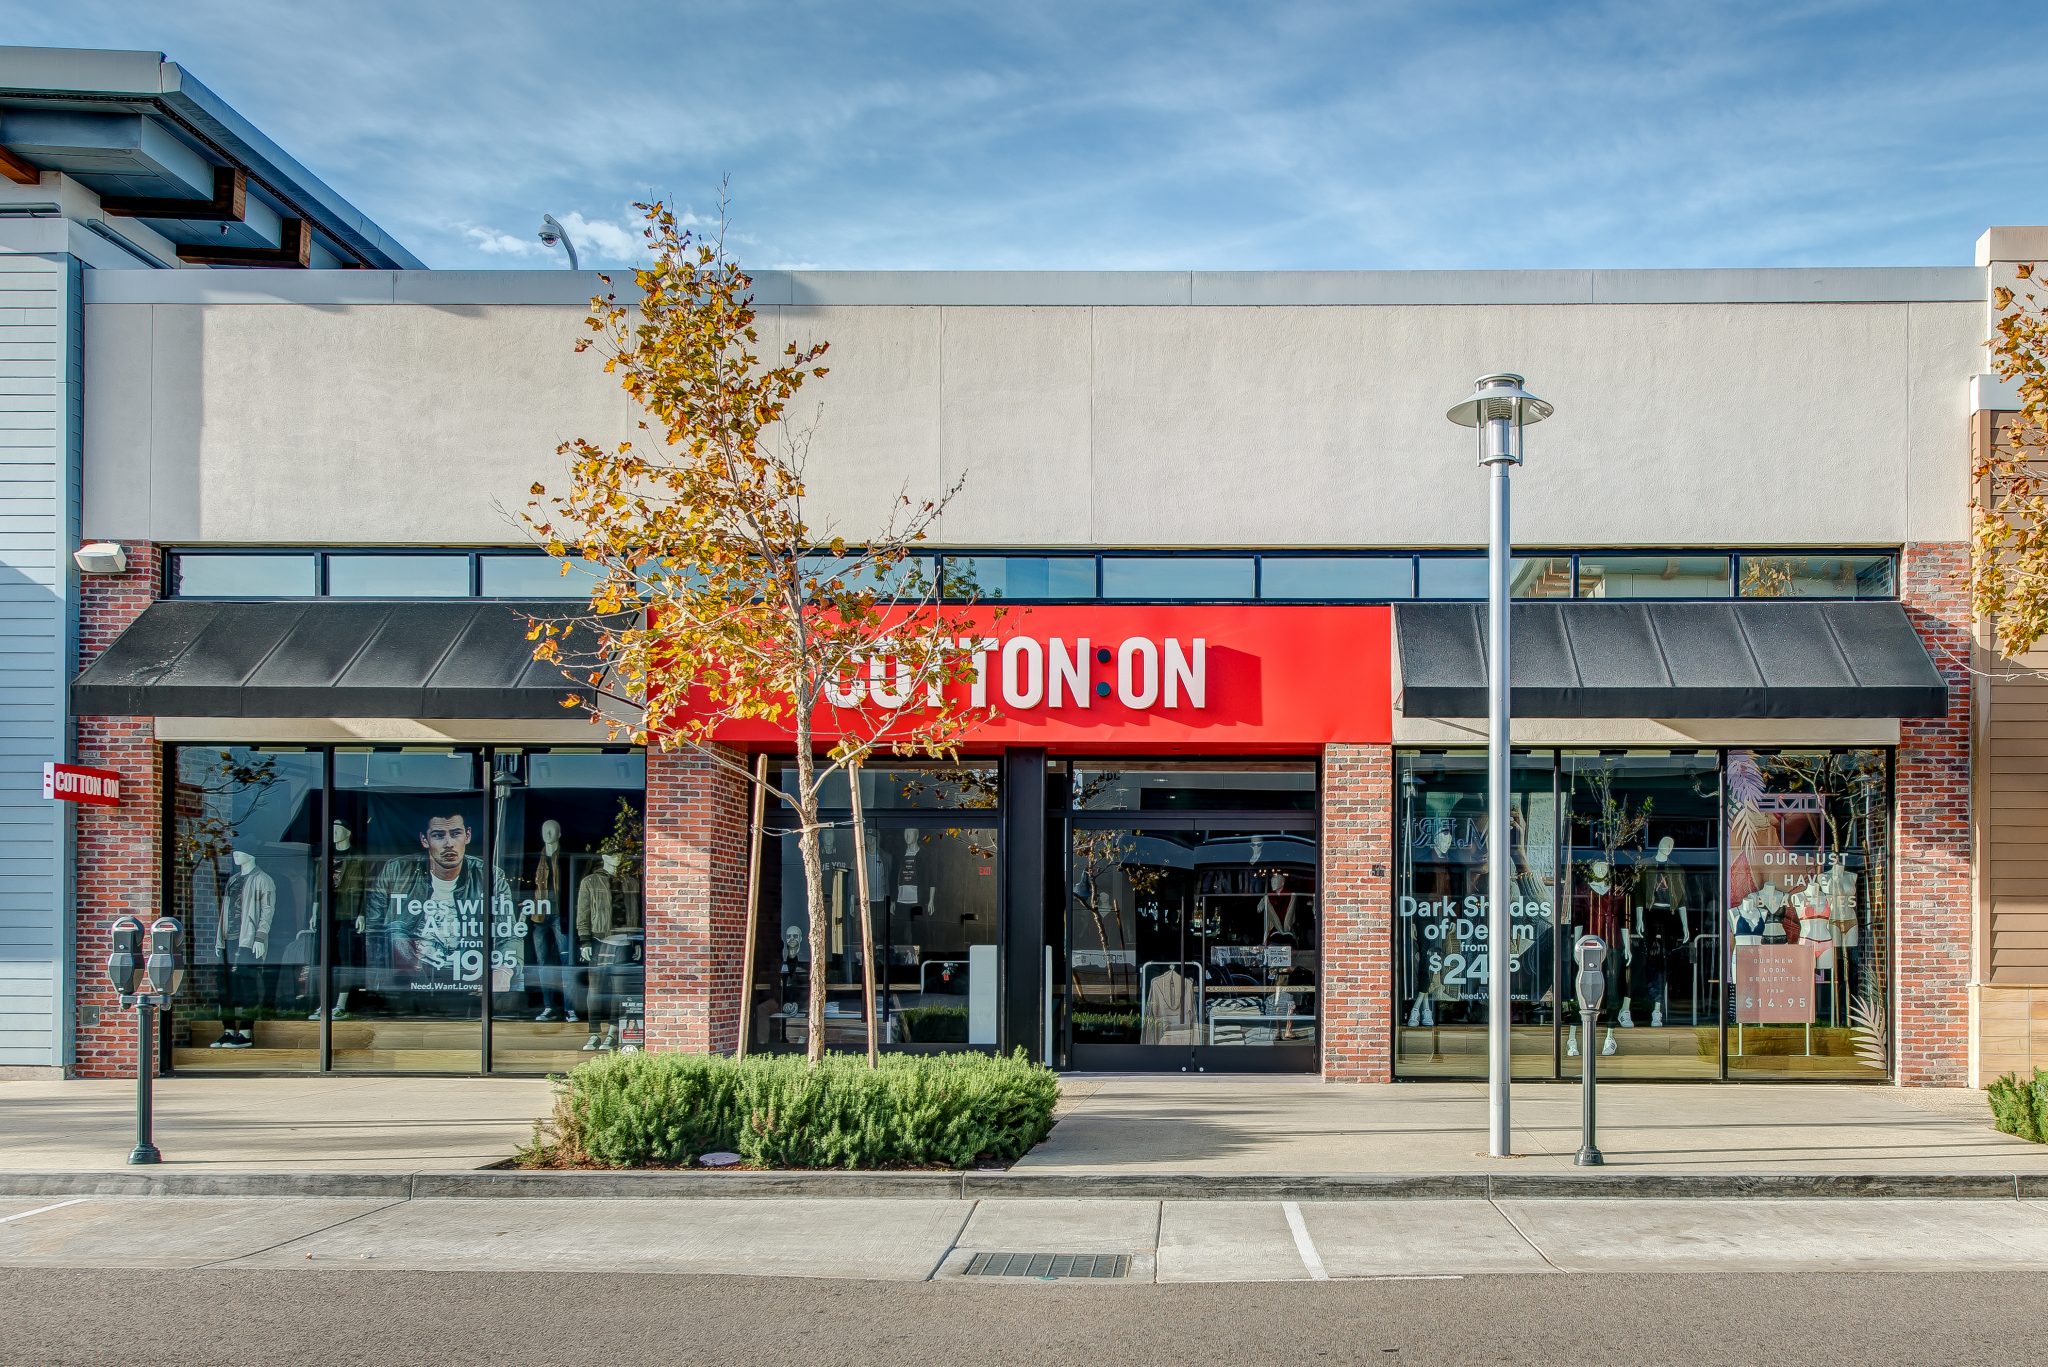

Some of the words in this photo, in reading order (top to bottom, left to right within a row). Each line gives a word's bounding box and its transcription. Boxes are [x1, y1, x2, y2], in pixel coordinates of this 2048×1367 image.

[55, 771, 102, 796] COTTON
[103, 778, 119, 799] ON
[1763, 852, 1798, 866] OUR
[1805, 852, 1849, 866] LUST
[390, 893, 450, 915] Tees
[456, 893, 514, 915] with
[521, 899, 551, 915] an
[1400, 895, 1457, 917] Dark
[1463, 895, 1552, 917] Shdes
[1424, 918, 1449, 940] of
[1456, 919, 1534, 940] Dem
[1461, 941, 1488, 952] from
[1745, 997, 1806, 1009] $14.95
